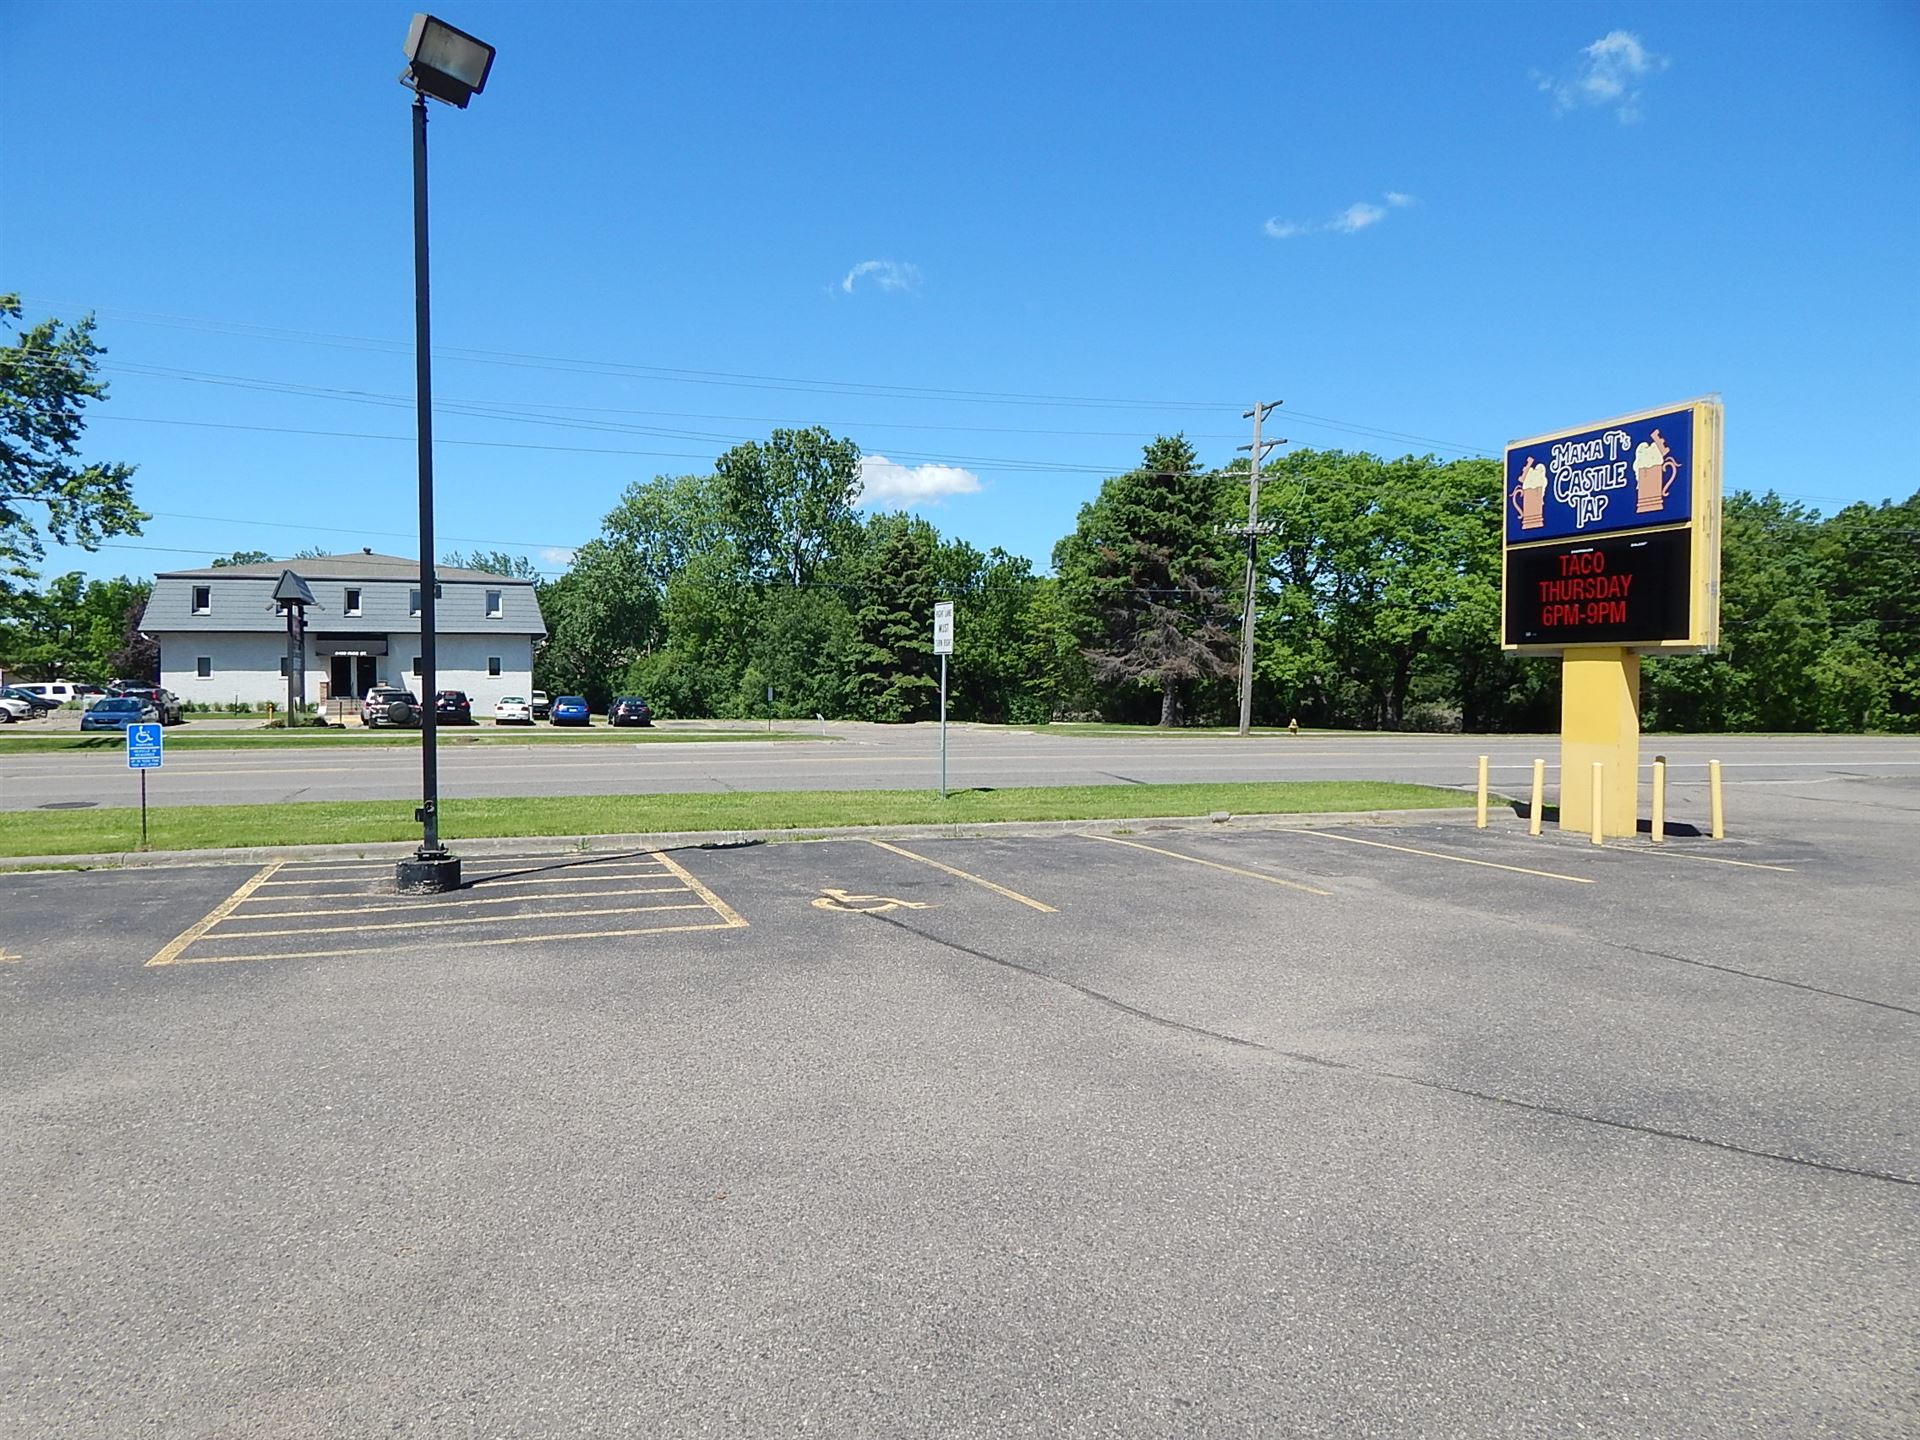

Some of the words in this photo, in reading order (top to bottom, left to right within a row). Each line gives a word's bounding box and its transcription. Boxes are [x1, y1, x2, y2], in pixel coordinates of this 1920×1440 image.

[1568, 493, 1608, 529] TAP
[1559, 551, 1605, 577] TACO
[1539, 574, 1633, 602] THURSDAY
[1543, 600, 1627, 626] 6PM-9PM
[938, 623, 949, 633] MUST
